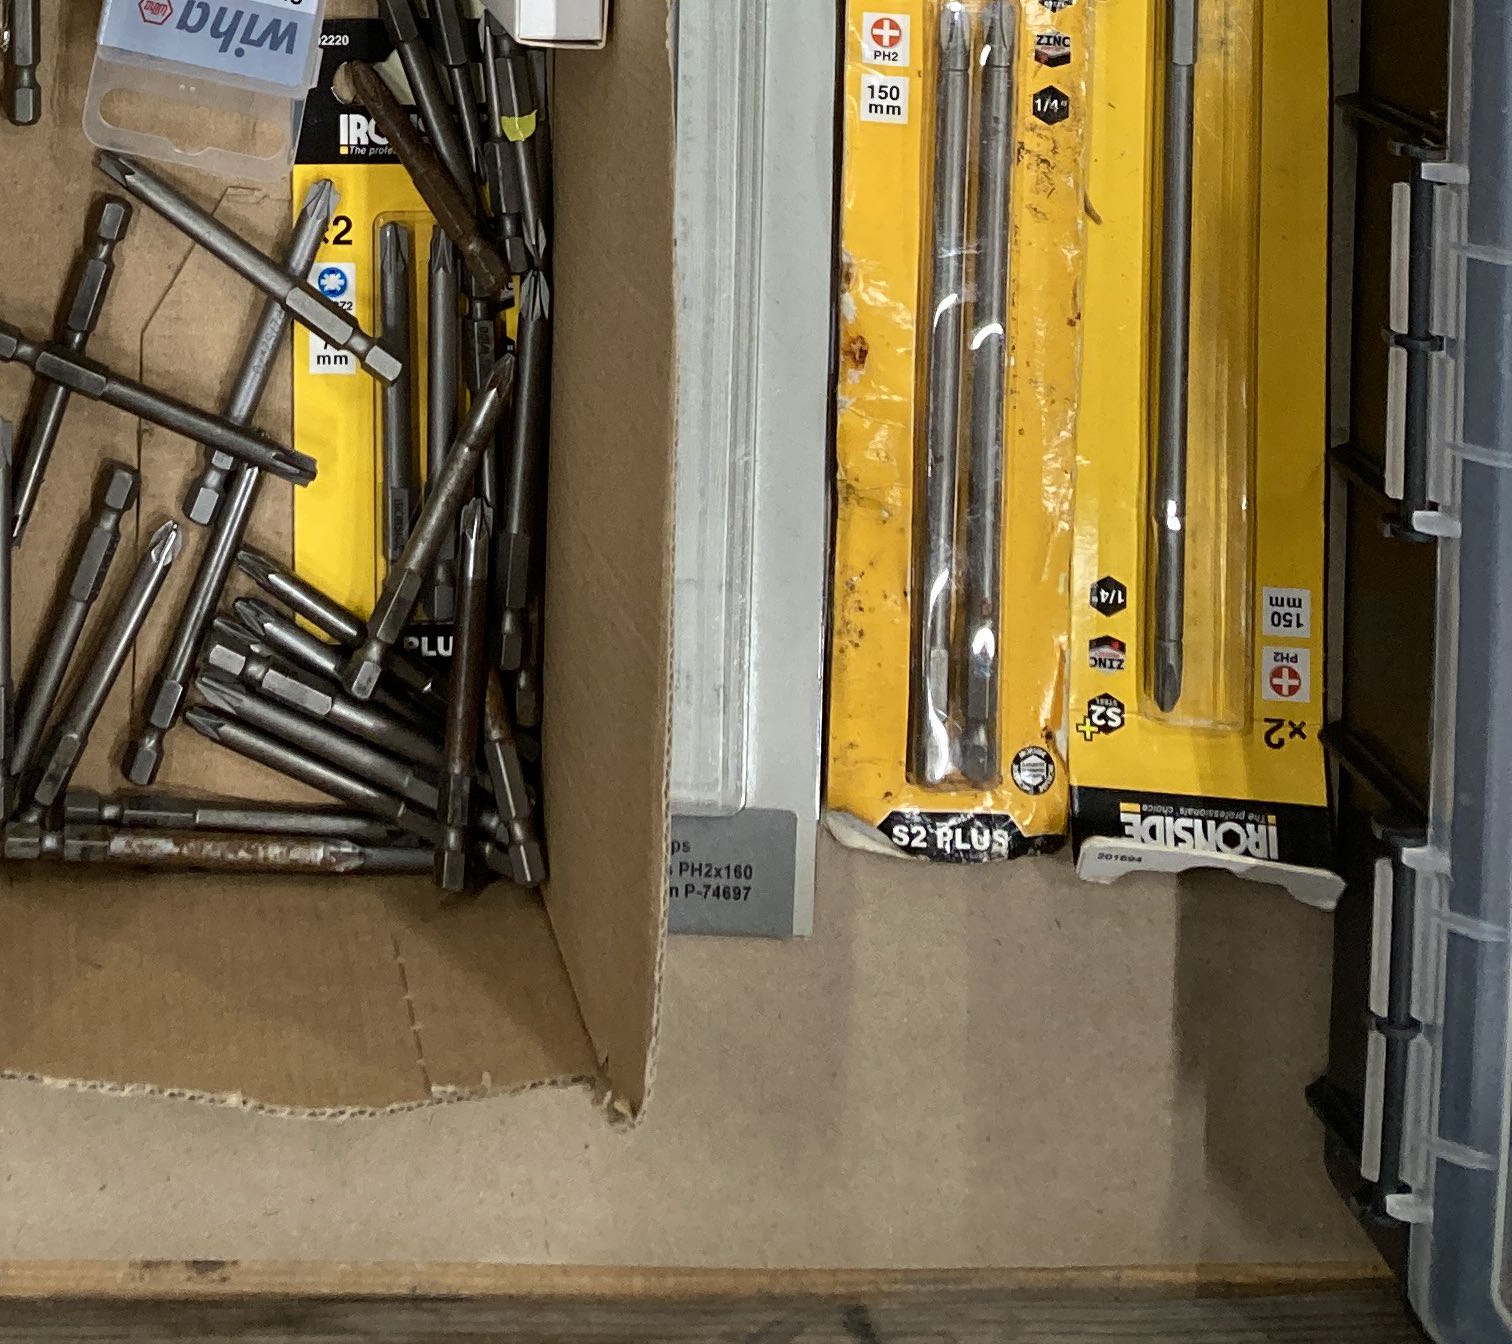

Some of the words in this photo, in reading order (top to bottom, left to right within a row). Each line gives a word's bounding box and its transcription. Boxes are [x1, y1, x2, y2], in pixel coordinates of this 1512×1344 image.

[318, 34, 350, 47] 2220
[1035, 34, 1070, 48] ZINC
[873, 48, 899, 62] PH2
[867, 84, 900, 102] 150
[869, 102, 901, 116] mm
[317, 353, 349, 366] mm
[1269, 595, 1303, 609] mm
[1270, 611, 1304, 629] 150
[1089, 655, 1125, 671] ZINC
[1273, 651, 1298, 664] PH2
[1142, 803, 1175, 815] choice
[1247, 812, 1267, 825] The
[892, 825, 927, 848] S2
[936, 826, 1010, 854] PLUS
[679, 862, 753, 881] PH2x160
[684, 883, 752, 902] P-74697
